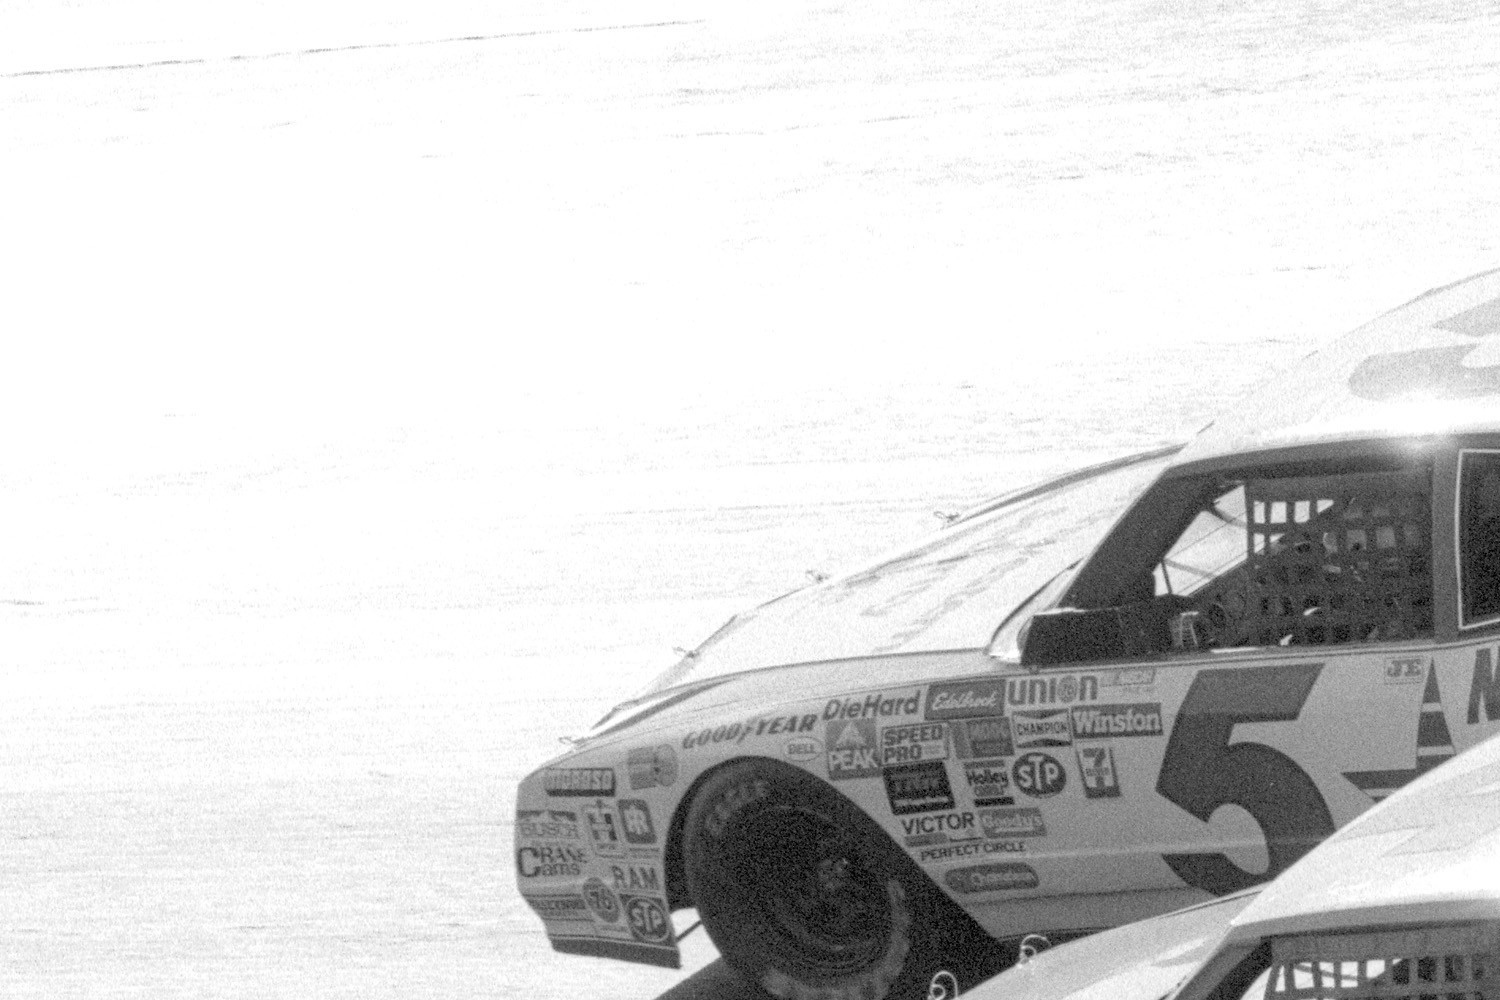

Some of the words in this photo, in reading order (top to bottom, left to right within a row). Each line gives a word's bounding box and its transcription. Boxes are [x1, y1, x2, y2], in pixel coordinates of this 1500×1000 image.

[822, 690, 922, 721] DieHard
[683, 714, 818, 750] GOODYEAR
[1016, 721, 1068, 737] CHAMPION
[1073, 709, 1161, 734] Winston
[884, 727, 943, 746] SPEED
[829, 749, 877, 770] PEAK
[885, 745, 922, 763] PRO
[966, 769, 1009, 788] Holley
[1018, 755, 1059, 790] STP
[1156, 663, 1336, 893] 5
[901, 812, 974, 834] VICTOR
[921, 844, 979, 861] PERFECT
[983, 841, 1026, 854] CIRCLE
[612, 866, 660, 890] RAM
[631, 902, 663, 933] STP
